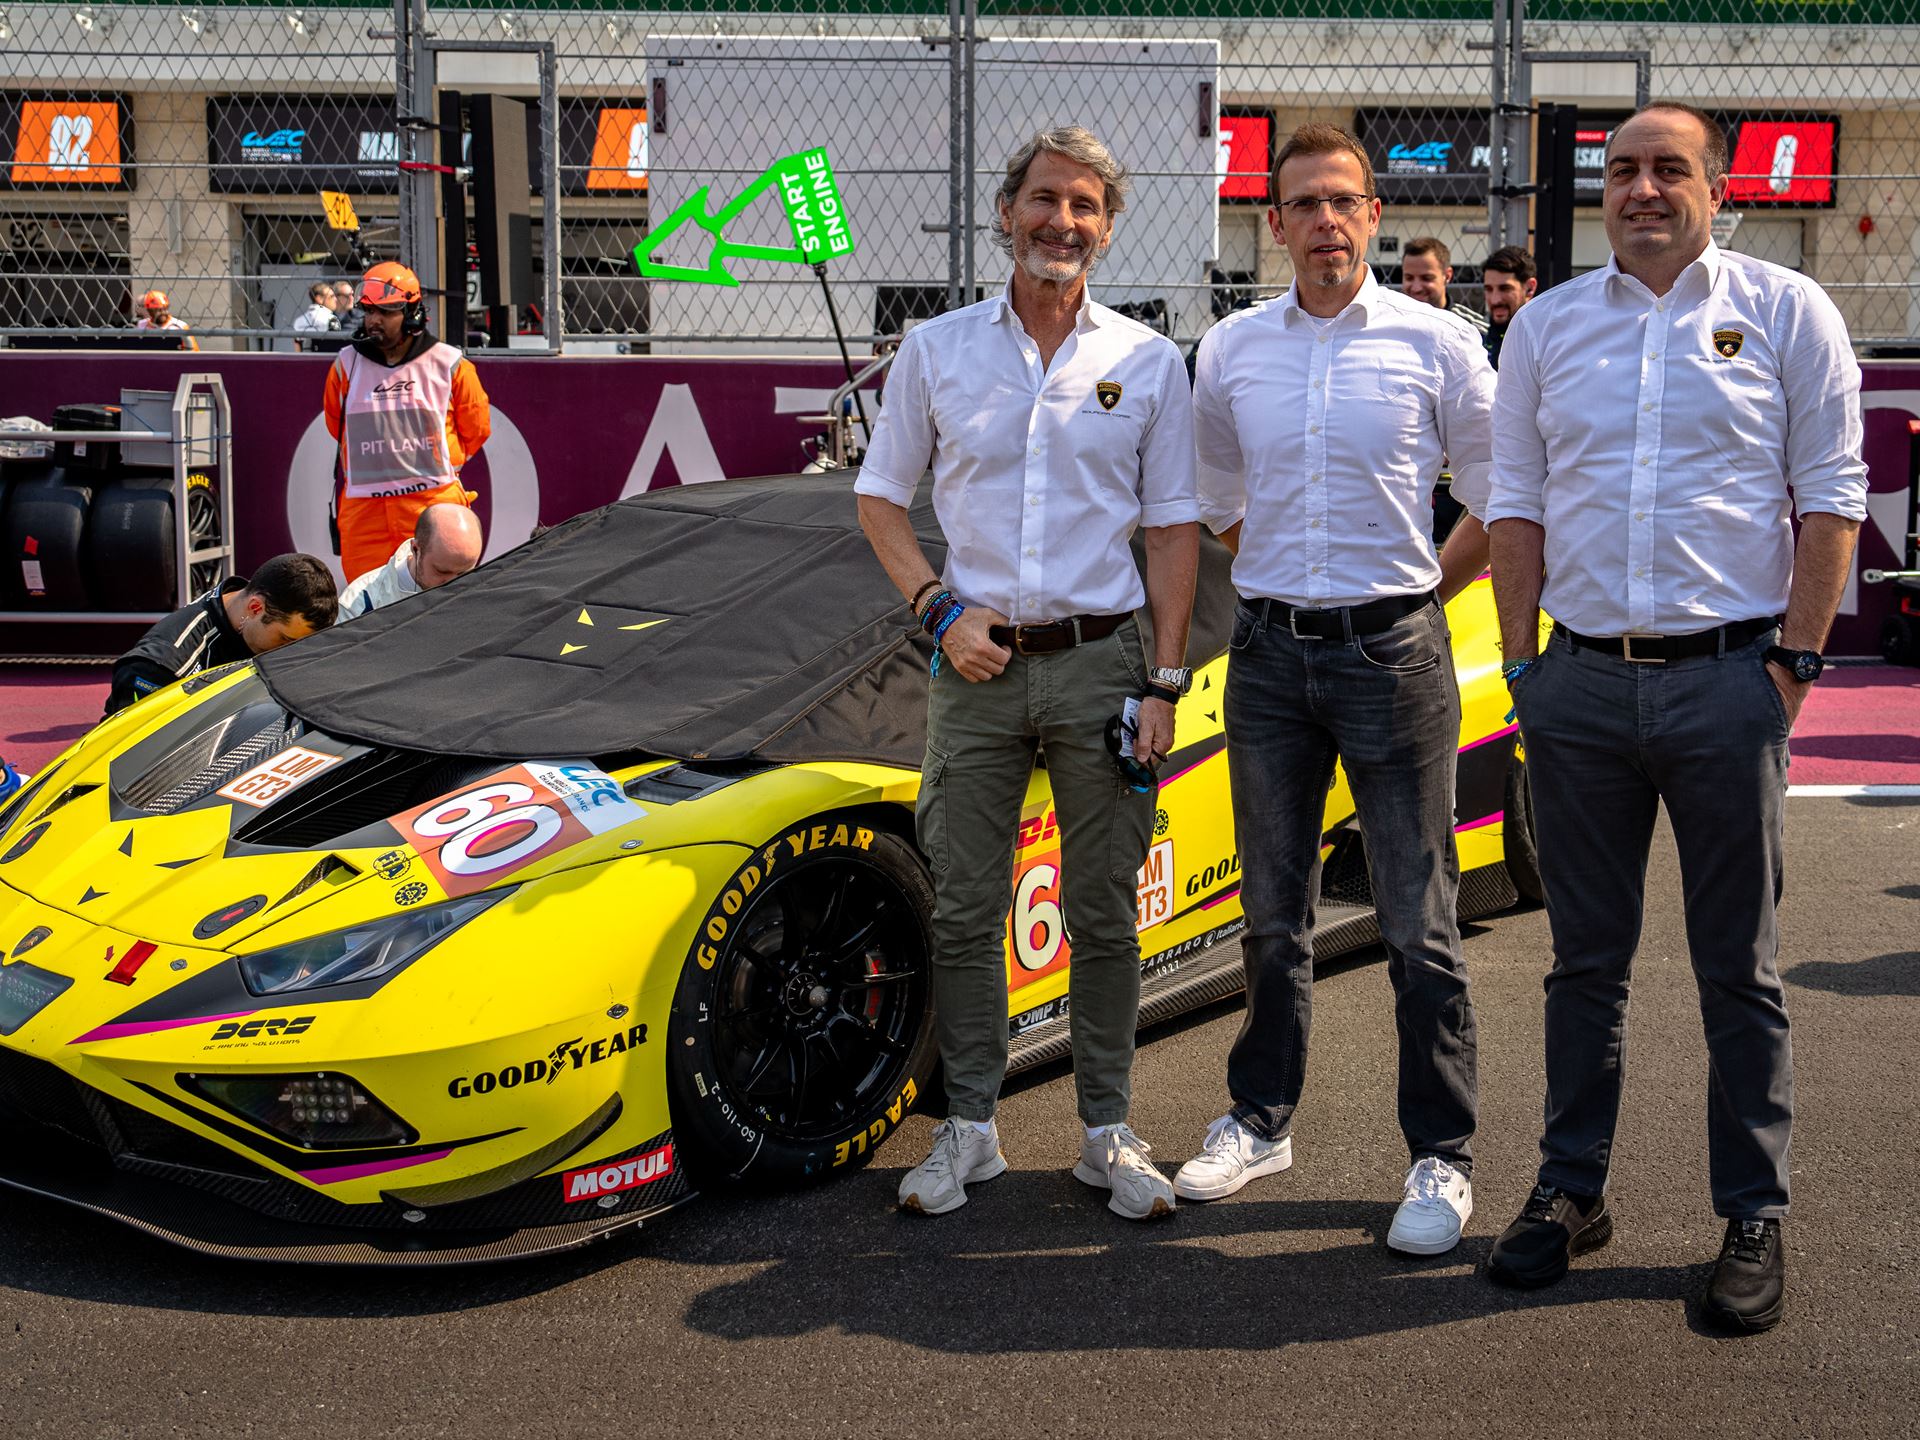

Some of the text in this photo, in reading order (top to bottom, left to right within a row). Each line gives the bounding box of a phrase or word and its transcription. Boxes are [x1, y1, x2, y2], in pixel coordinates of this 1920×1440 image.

[48, 115, 93, 171] 92
[781, 172, 820, 253] START
[804, 152, 849, 253] ENGINE
[361, 438, 434, 455] PIT LANE
[232, 773, 292, 800] GT3
[271, 754, 325, 778] LM
[411, 781, 564, 876] 60
[697, 824, 874, 970] GOODYEAR
[1186, 853, 1241, 897] GOOD
[1012, 864, 1073, 971] 6
[1140, 936, 1202, 972] CARRARO
[1156, 960, 1180, 978] 1927
[448, 1023, 648, 1099] GOODYEAR
[832, 1077, 918, 1168] EAGLE
[570, 1150, 669, 1198] MOTUL
